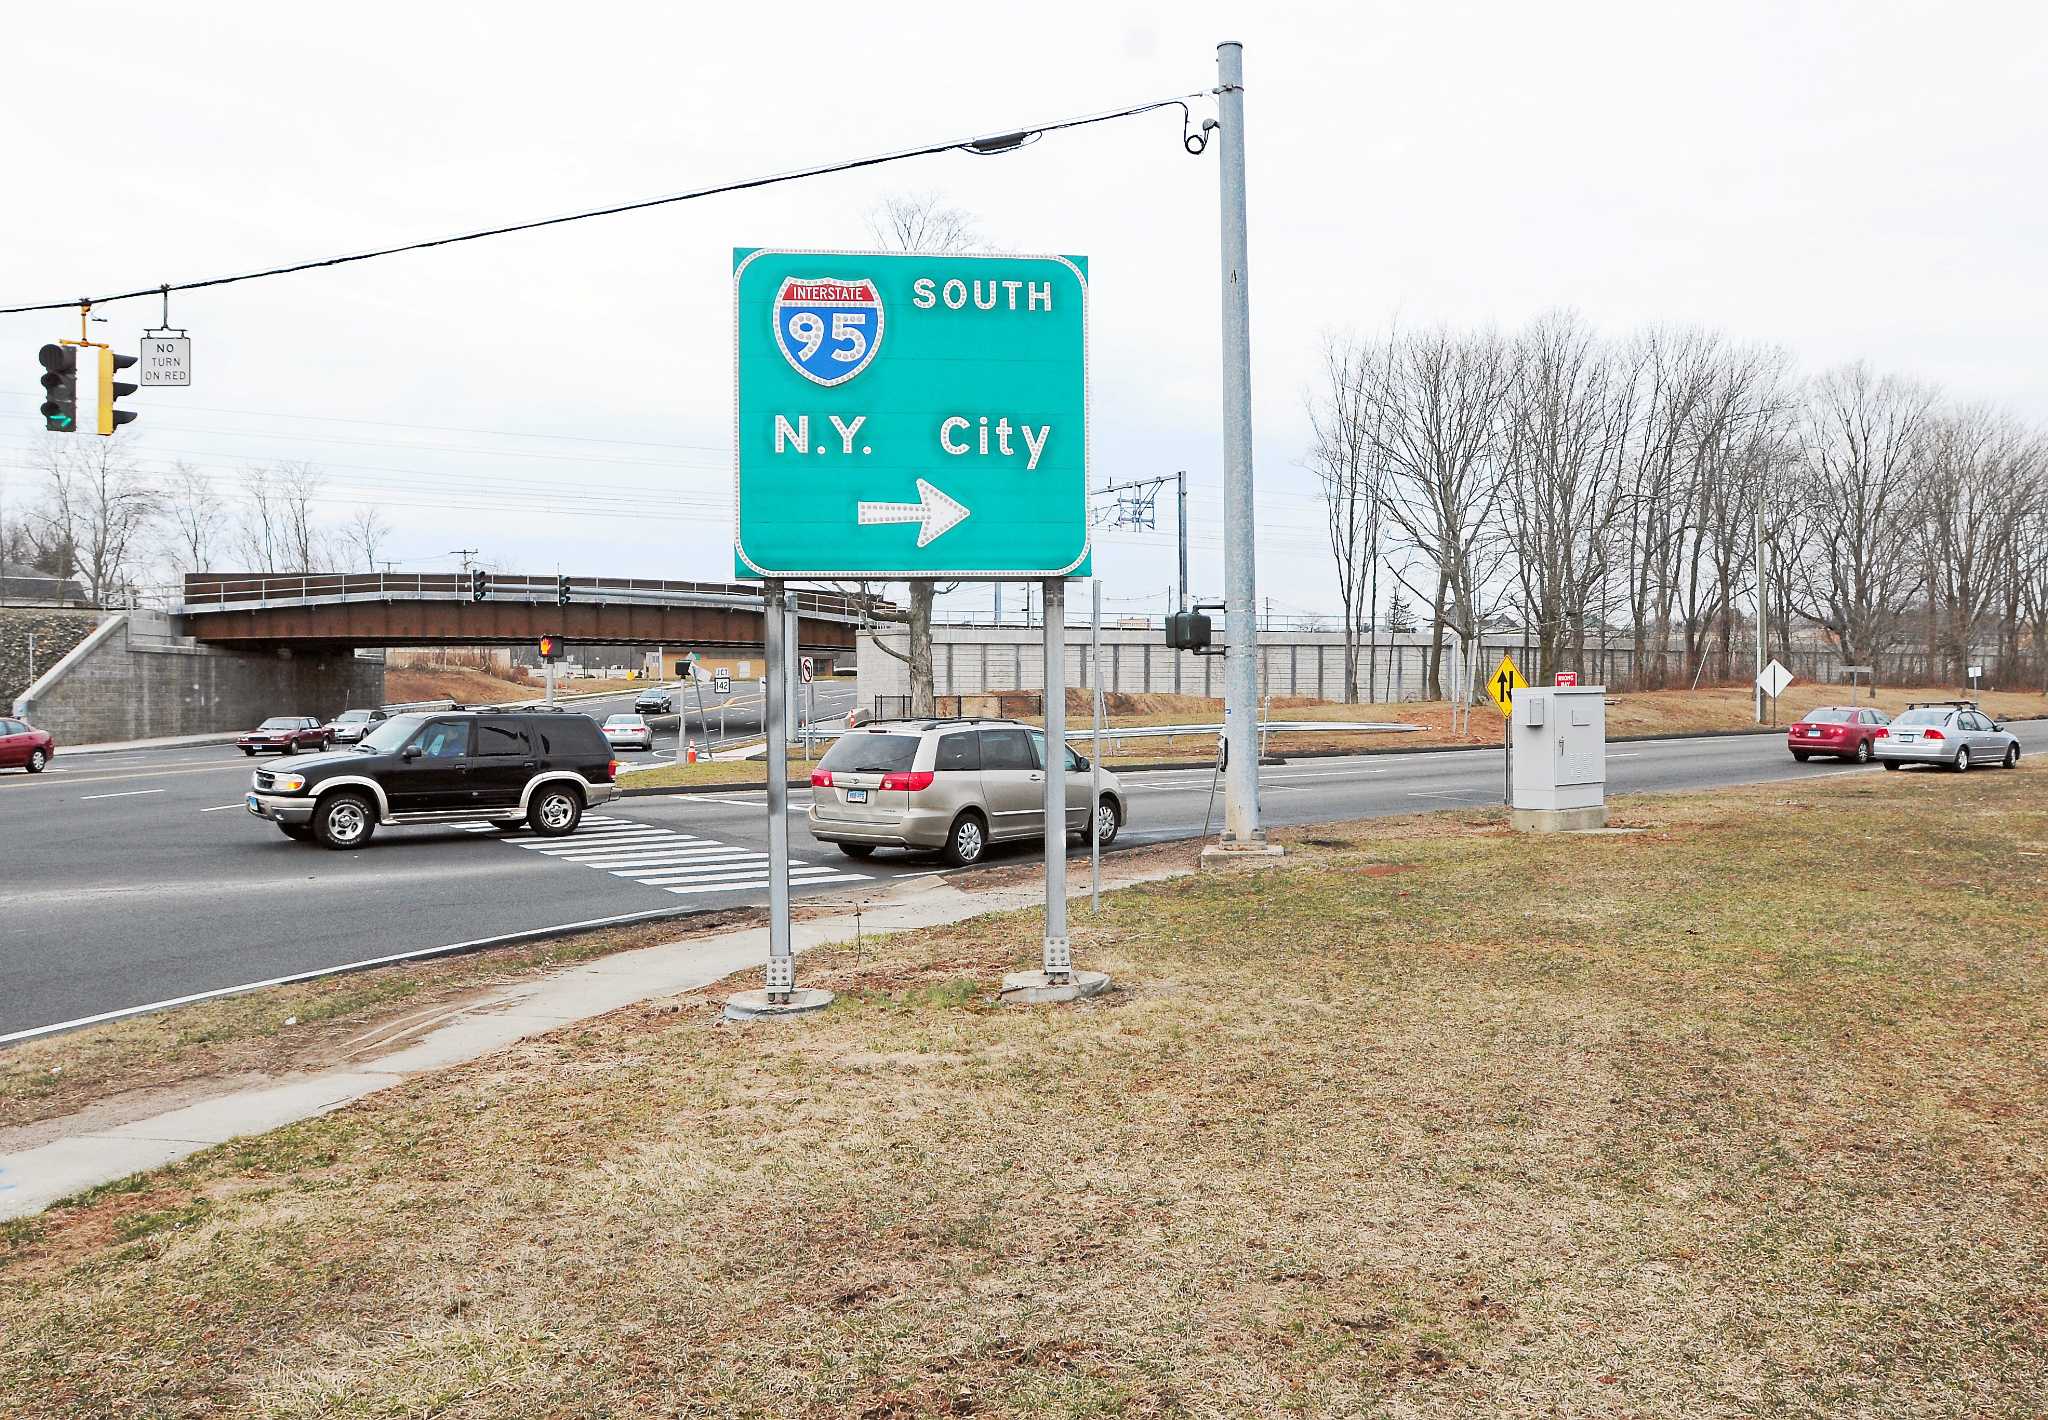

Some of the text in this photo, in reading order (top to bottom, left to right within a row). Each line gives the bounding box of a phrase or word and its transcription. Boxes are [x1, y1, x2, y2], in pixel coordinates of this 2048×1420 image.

[793, 286, 864, 301] INTERSTATE
[912, 278, 1053, 312] SOUTH
[788, 312, 867, 363] 95
[156, 343, 174, 353] NO
[151, 357, 181, 367] TURN
[145, 371, 186, 380] ON RED
[774, 414, 1051, 470] N.Y. City
[716, 681, 729, 690] 142
